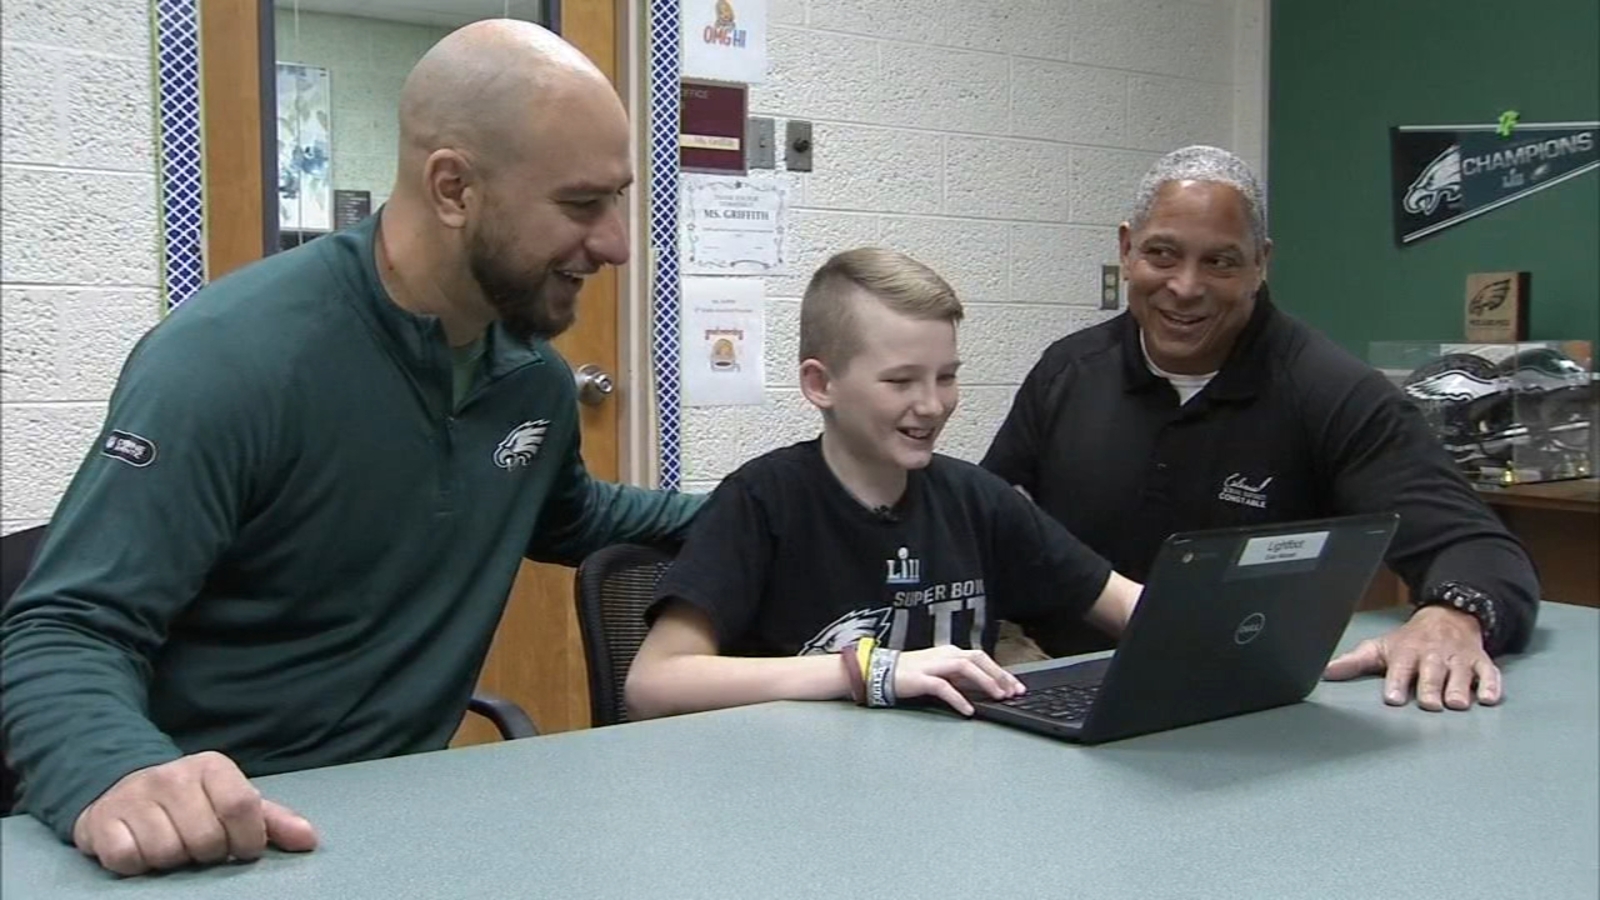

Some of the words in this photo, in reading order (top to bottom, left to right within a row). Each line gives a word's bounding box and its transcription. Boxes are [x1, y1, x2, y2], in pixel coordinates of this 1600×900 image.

[703, 25, 731, 46] OMG
[733, 29, 747, 48] HI
[1462, 132, 1594, 176] CHAMPIONS
[704, 209, 721, 218] MS.
[1218, 492, 1267, 508] CONSTABLE
[893, 584, 946, 607] SUPER
